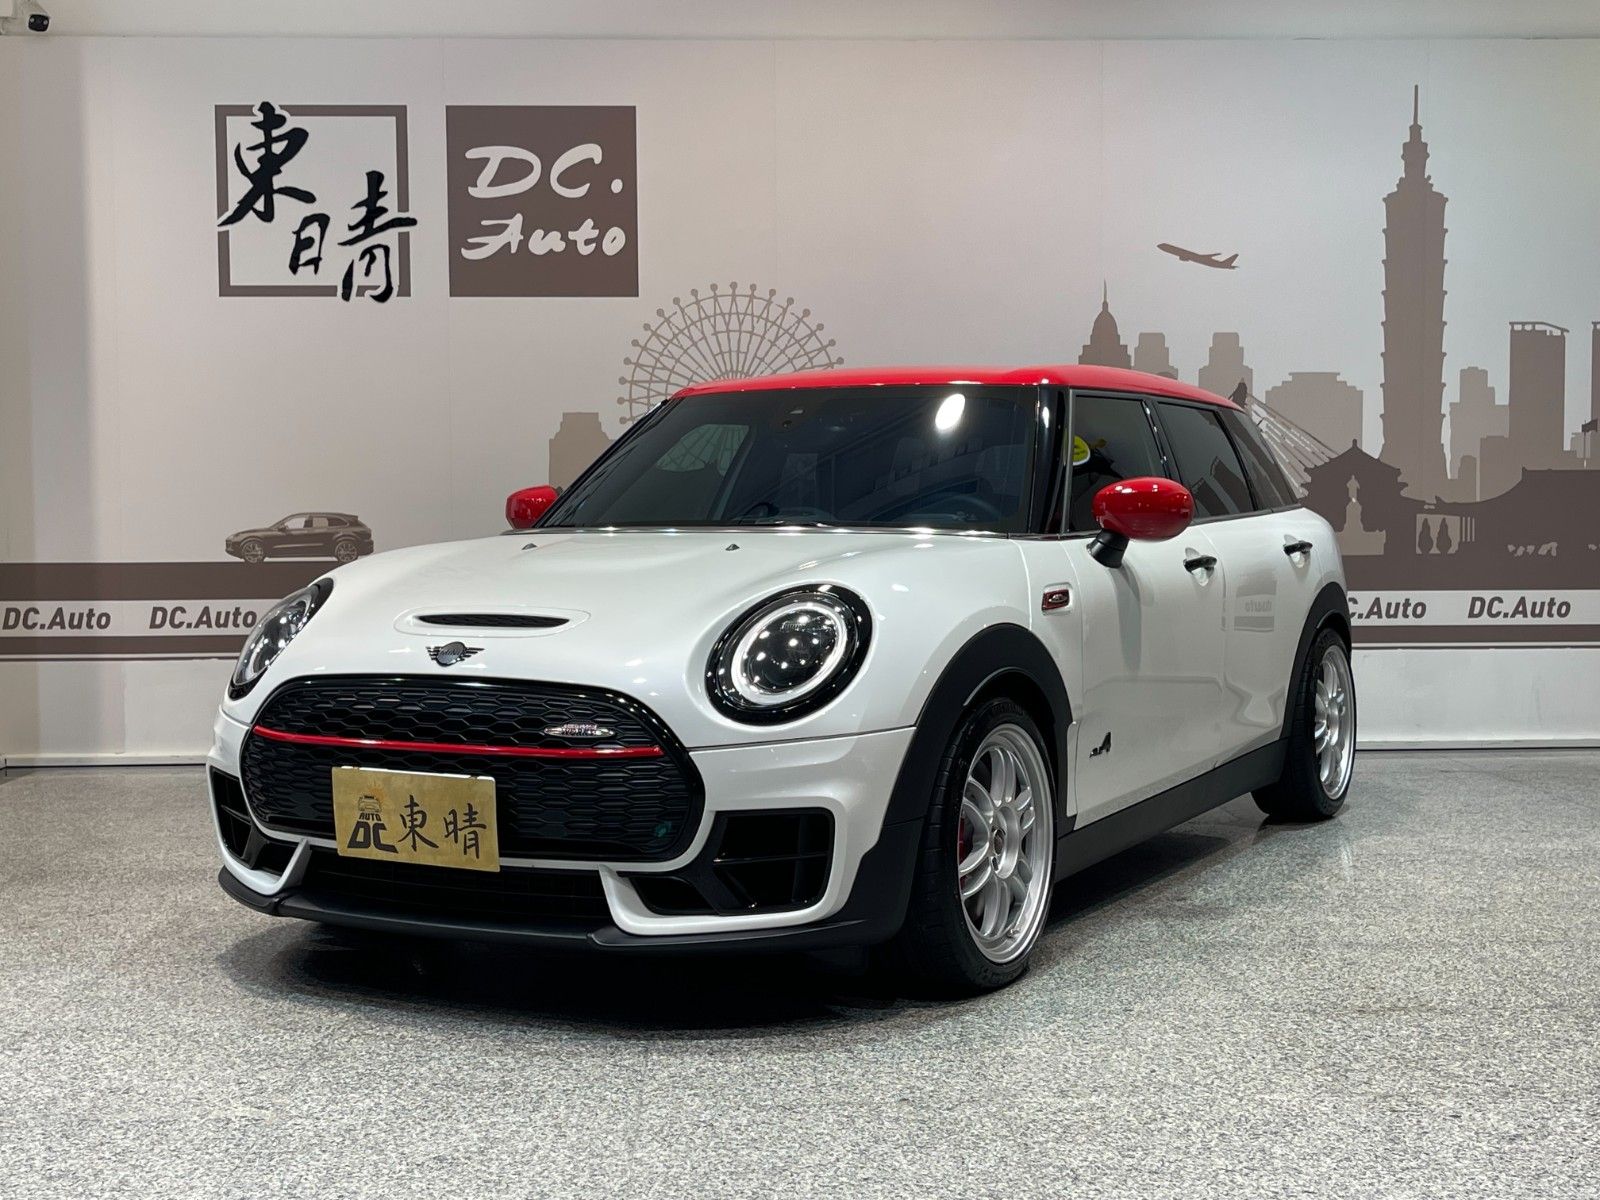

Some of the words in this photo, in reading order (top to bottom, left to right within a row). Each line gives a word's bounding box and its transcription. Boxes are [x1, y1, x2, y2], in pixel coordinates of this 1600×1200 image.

[465, 143, 624, 199] DC.
[461, 213, 626, 260] Auto
[2, 606, 111, 630] DC.Auto
[149, 606, 257, 629] DC.Auto
[1348, 596, 1427, 619] C.Auto
[1467, 596, 1571, 618] DC.Auto
[358, 812, 382, 822] AUTO
[398, 795, 487, 859] 東晴
[347, 820, 399, 854] DC
